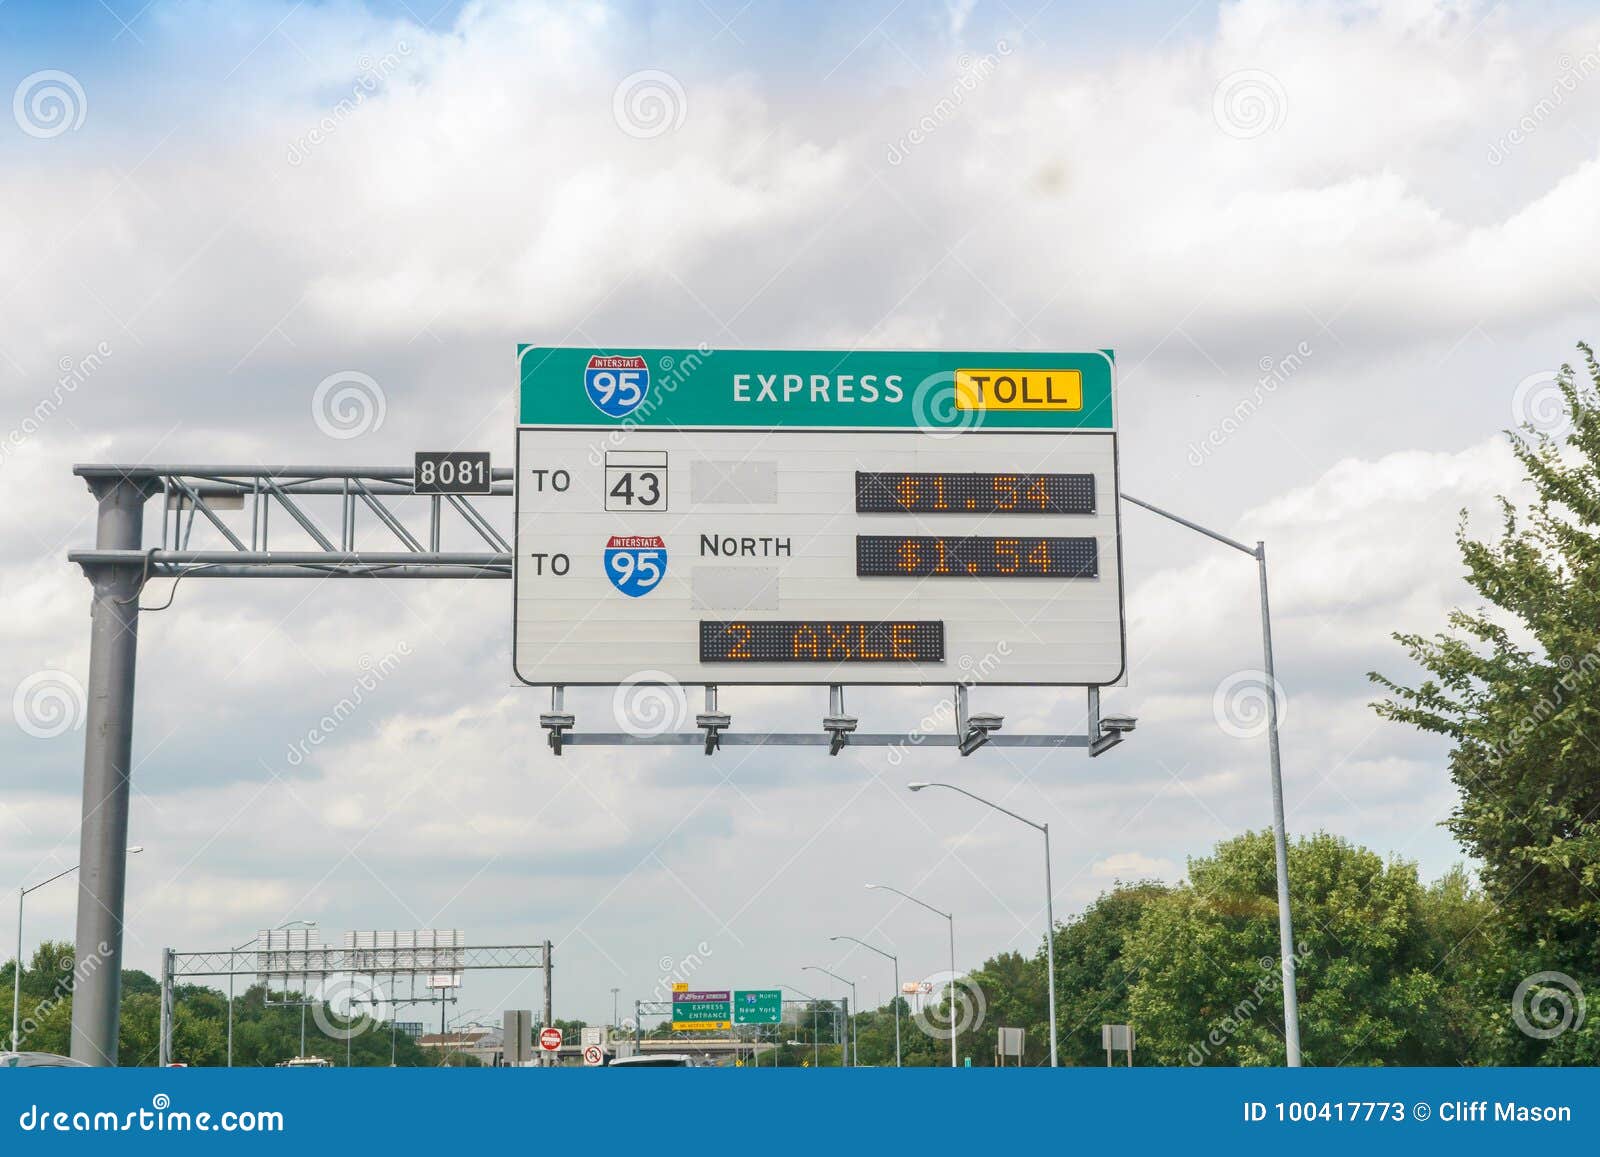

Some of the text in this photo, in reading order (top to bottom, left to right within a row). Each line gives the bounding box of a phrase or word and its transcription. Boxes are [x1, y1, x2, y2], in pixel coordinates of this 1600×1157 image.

[594, 358, 640, 368] INTERSTATE
[592, 371, 642, 407] 95
[732, 373, 904, 403] EXPRESS
[969, 375, 1068, 404] TOLL
[420, 460, 484, 485] 8081
[531, 469, 571, 492] TO
[609, 472, 661, 506] 43
[896, 475, 1050, 509] $1.54
[613, 537, 658, 548] INTERSTATE
[700, 534, 792, 558] NORTH
[897, 539, 1053, 573] $1.54
[531, 553, 570, 576] TO
[611, 551, 661, 588] 95
[727, 624, 918, 659] 2 AXLE
[759, 1006, 776, 1014] York
